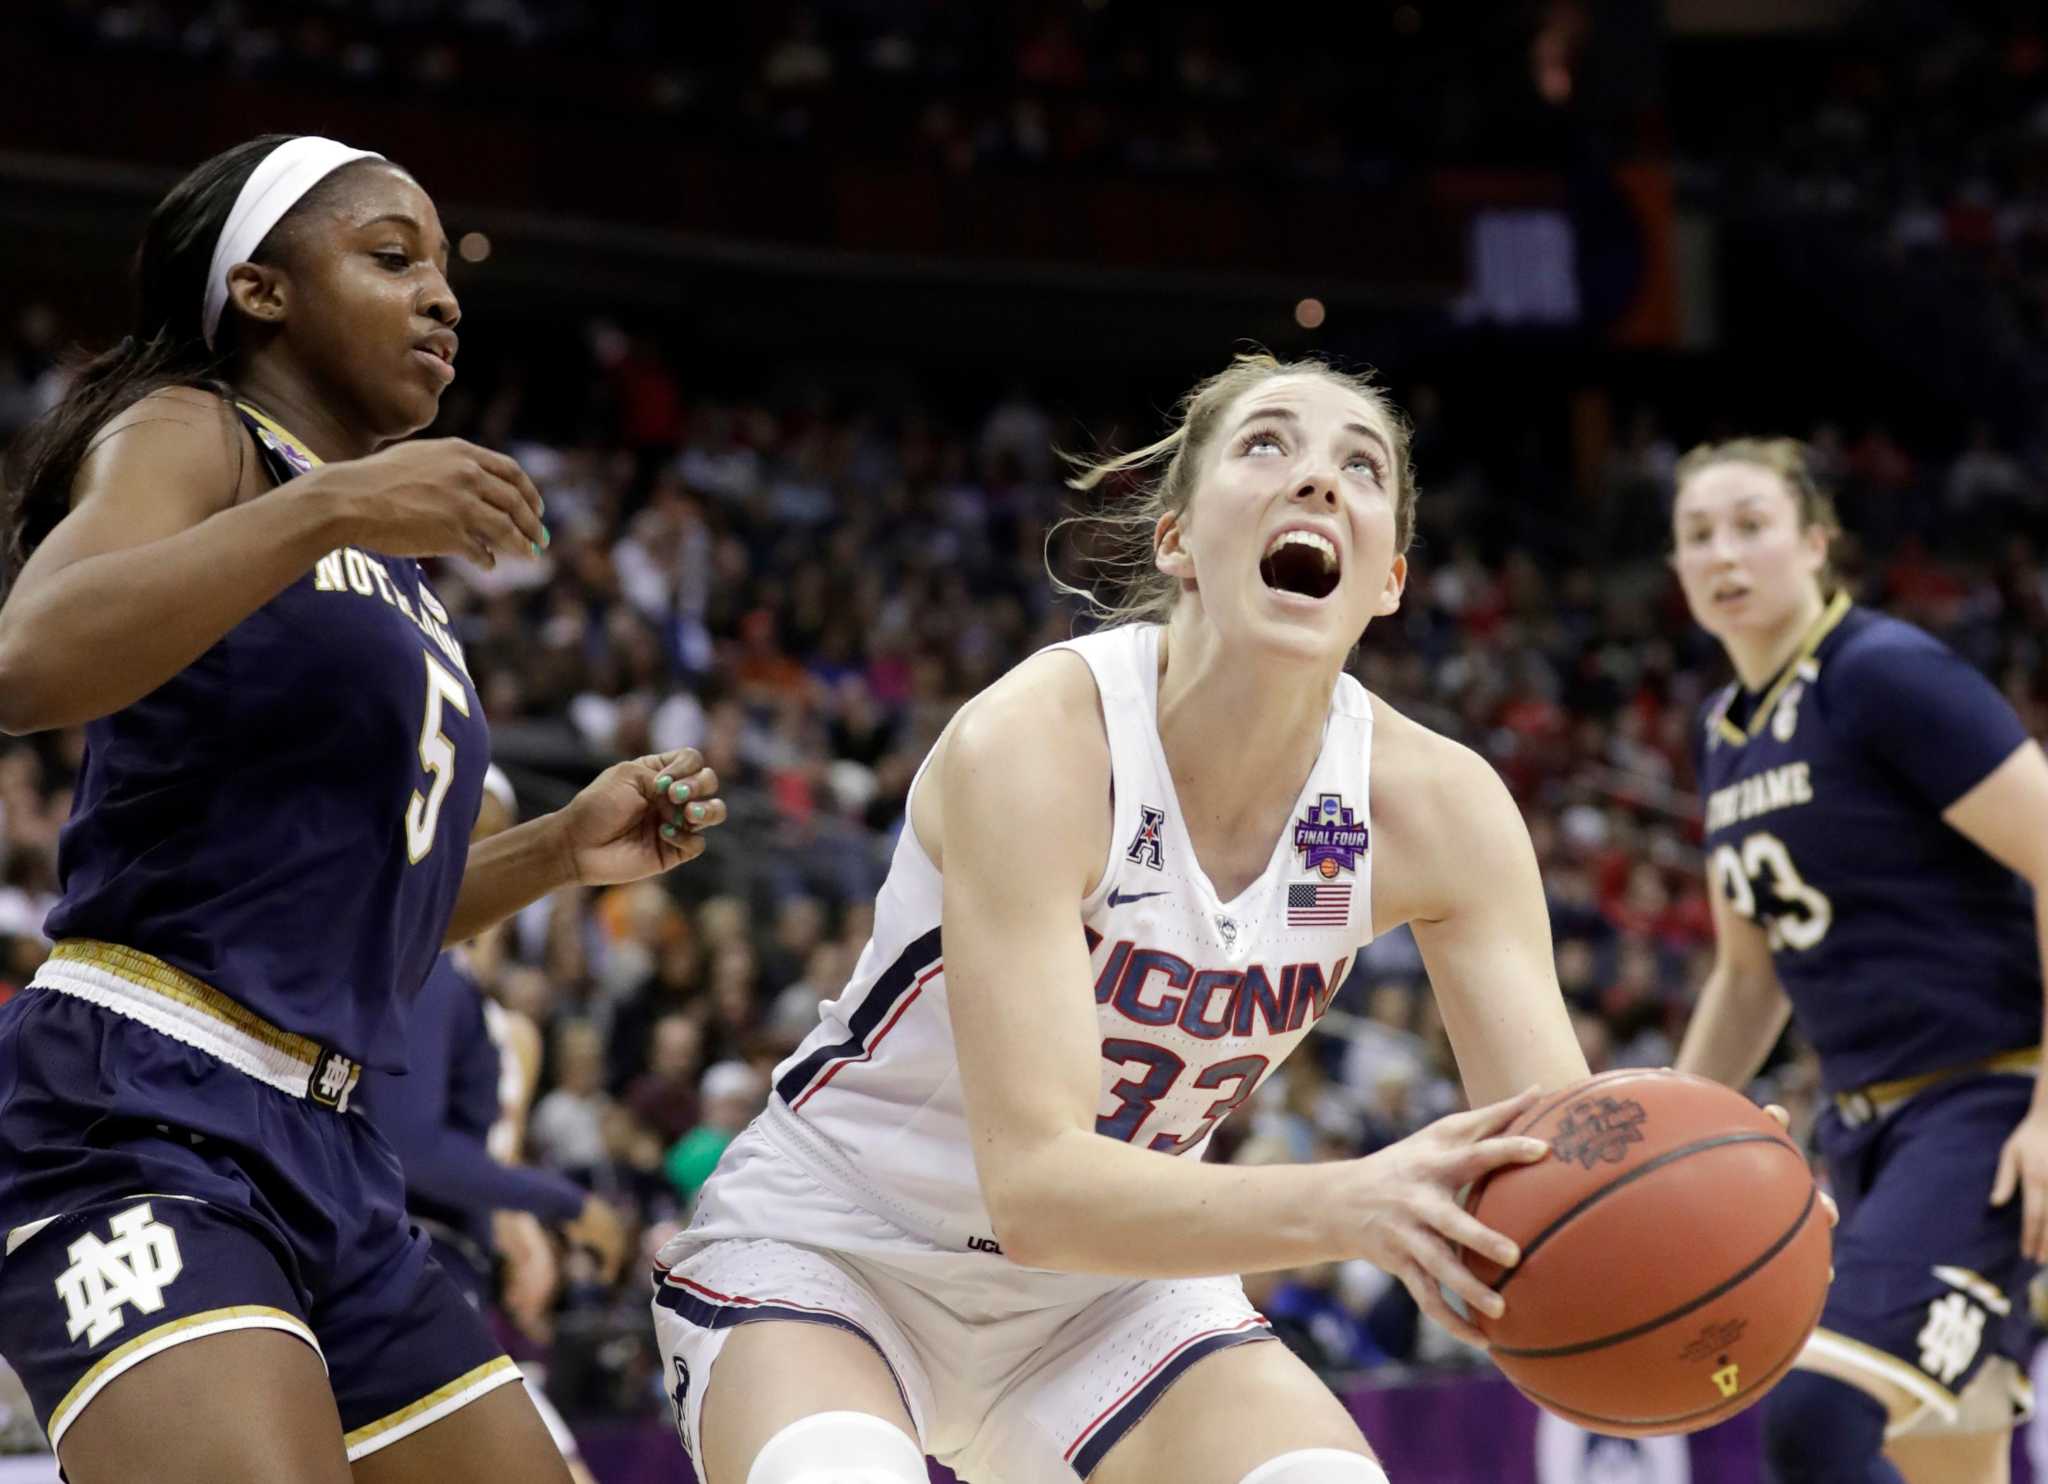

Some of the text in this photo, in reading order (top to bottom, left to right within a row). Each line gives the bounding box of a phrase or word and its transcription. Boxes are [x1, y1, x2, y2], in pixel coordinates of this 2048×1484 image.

[405, 648, 470, 865] 5
[1296, 829, 1367, 847] FINAL FOUR
